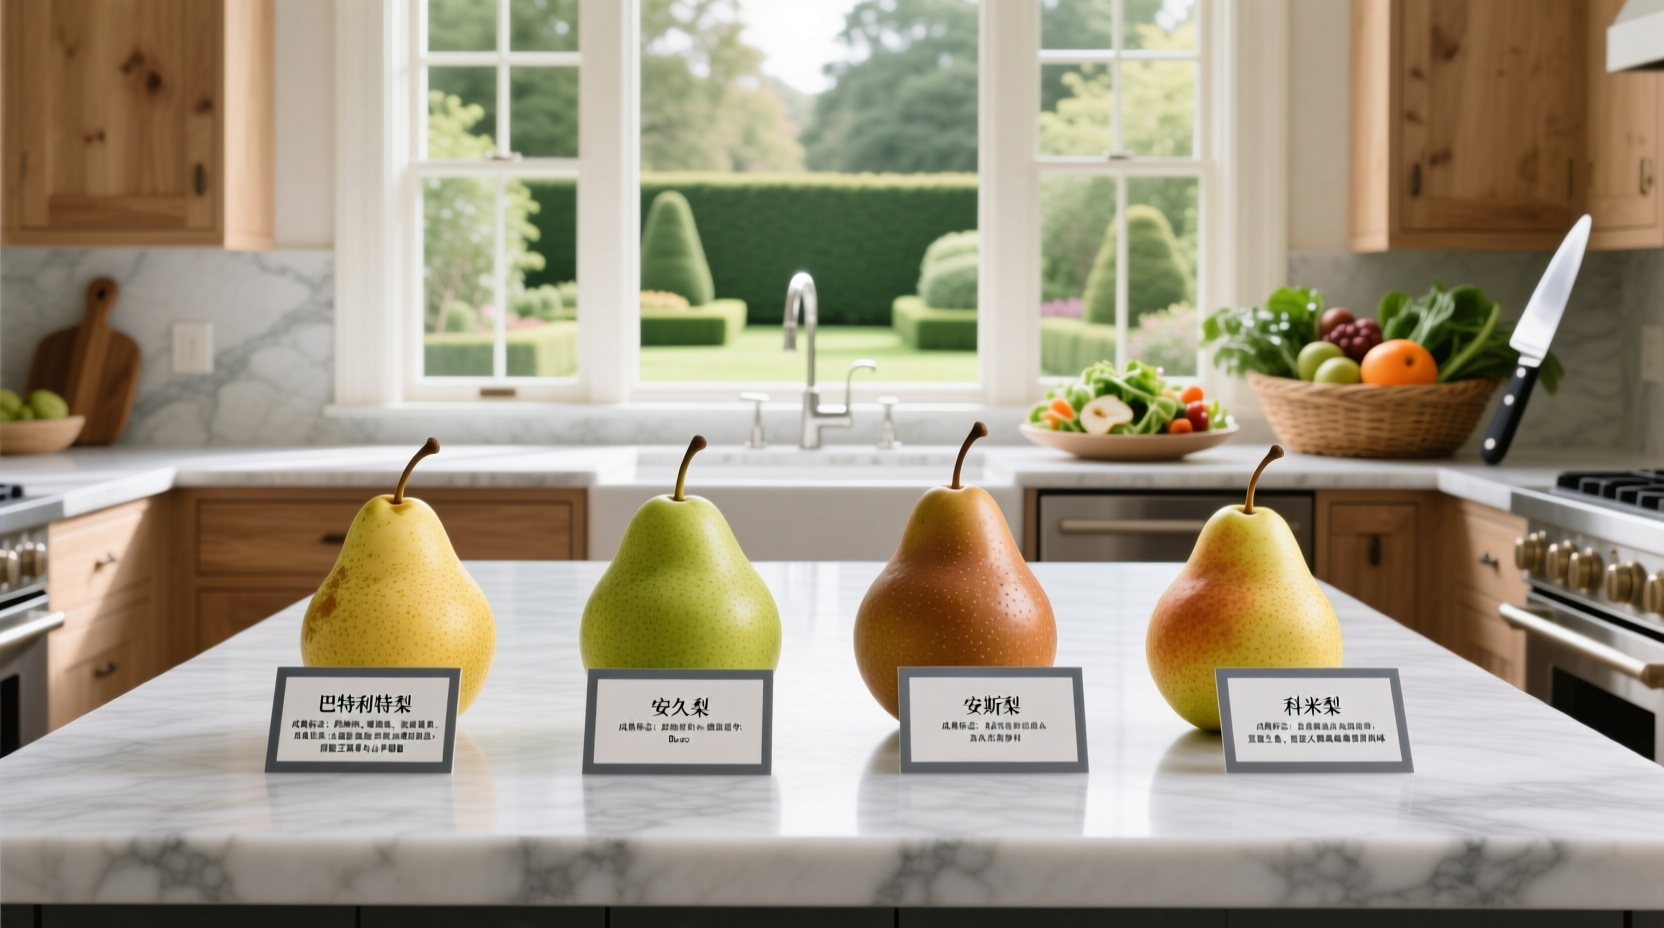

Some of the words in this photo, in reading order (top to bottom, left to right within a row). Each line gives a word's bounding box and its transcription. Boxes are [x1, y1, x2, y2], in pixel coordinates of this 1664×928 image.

[319, 694, 412, 714] 巴特利特梨
[651, 697, 710, 718] 安久梨
[963, 695, 1021, 716] 安斯梨
[1283, 695, 1341, 716] 科米梨
